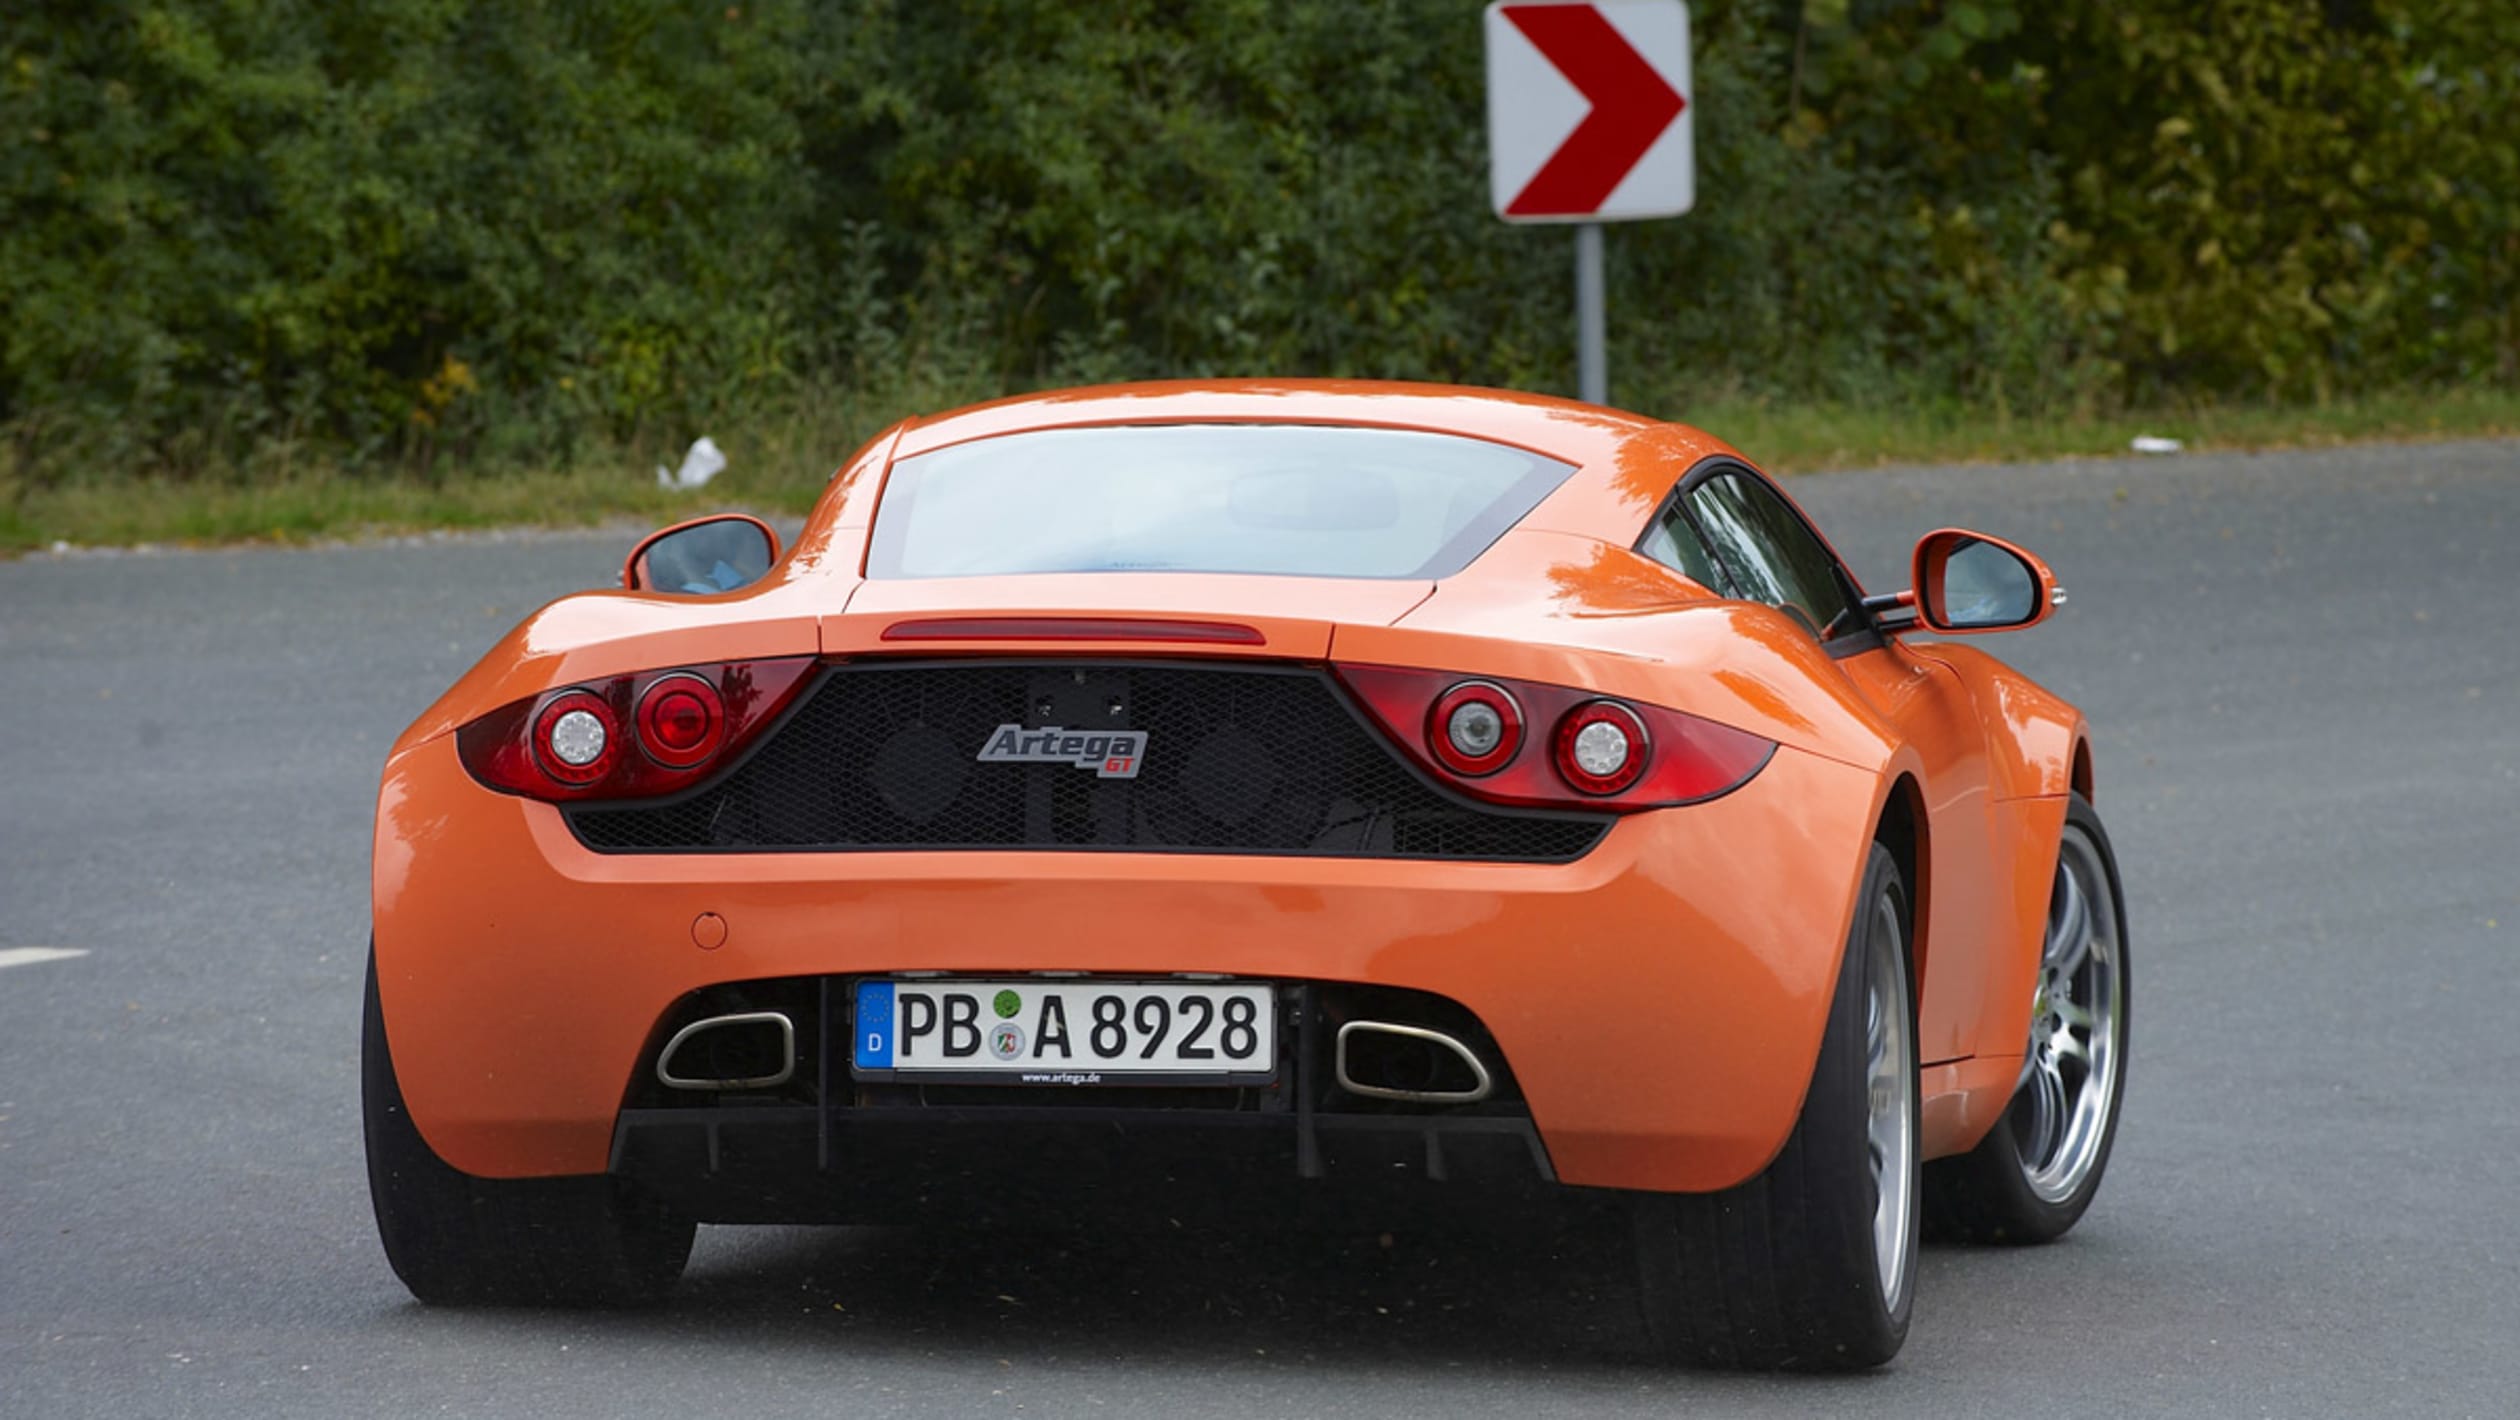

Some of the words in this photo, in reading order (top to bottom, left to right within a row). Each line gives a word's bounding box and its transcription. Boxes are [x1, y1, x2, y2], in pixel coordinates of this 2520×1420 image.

[989, 730, 1136, 761] Artega
[1104, 757, 1135, 773] GT
[899, 994, 982, 1057] PB
[1032, 995, 1072, 1058] A
[1090, 995, 1257, 1059] 8928
[868, 1034, 882, 1052] D
[1022, 1072, 1101, 1085] www.artega.de
